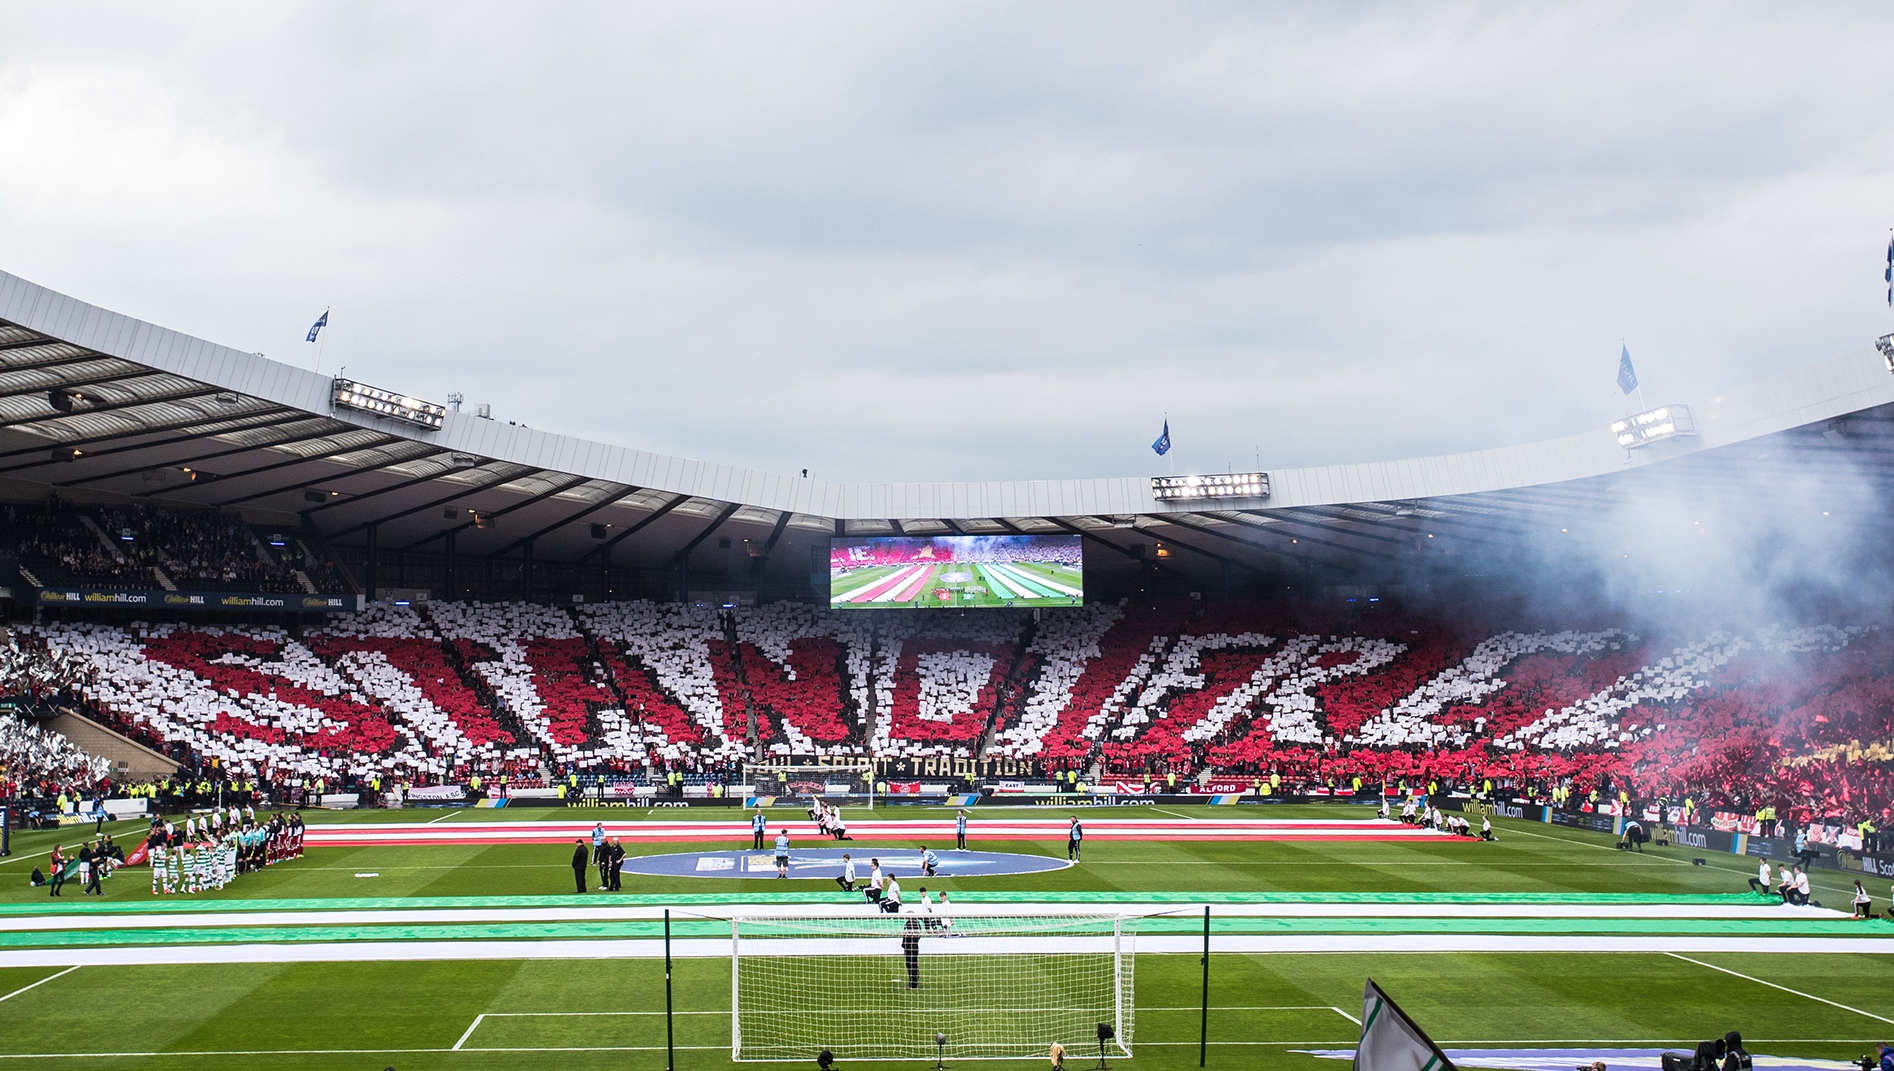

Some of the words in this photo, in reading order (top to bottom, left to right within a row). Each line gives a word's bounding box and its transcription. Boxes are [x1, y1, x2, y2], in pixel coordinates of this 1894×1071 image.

[66, 592, 80, 600] HILL
[84, 592, 147, 603] williamhill.com
[190, 595, 205, 604] HILL
[221, 596, 284, 607] williamhill.com
[328, 598, 343, 606] HILL
[911, 757, 1033, 777] TRADITION
[1199, 784, 1236, 793] ALFORD
[567, 798, 690, 808] williamhillcom
[1035, 796, 1155, 806] williamhillcom
[1462, 798, 1524, 819] williamhill.com
[1649, 822, 1707, 849] williamhill.com
[1862, 855, 1878, 874] HILL
[1879, 859, 1894, 877] Sco
